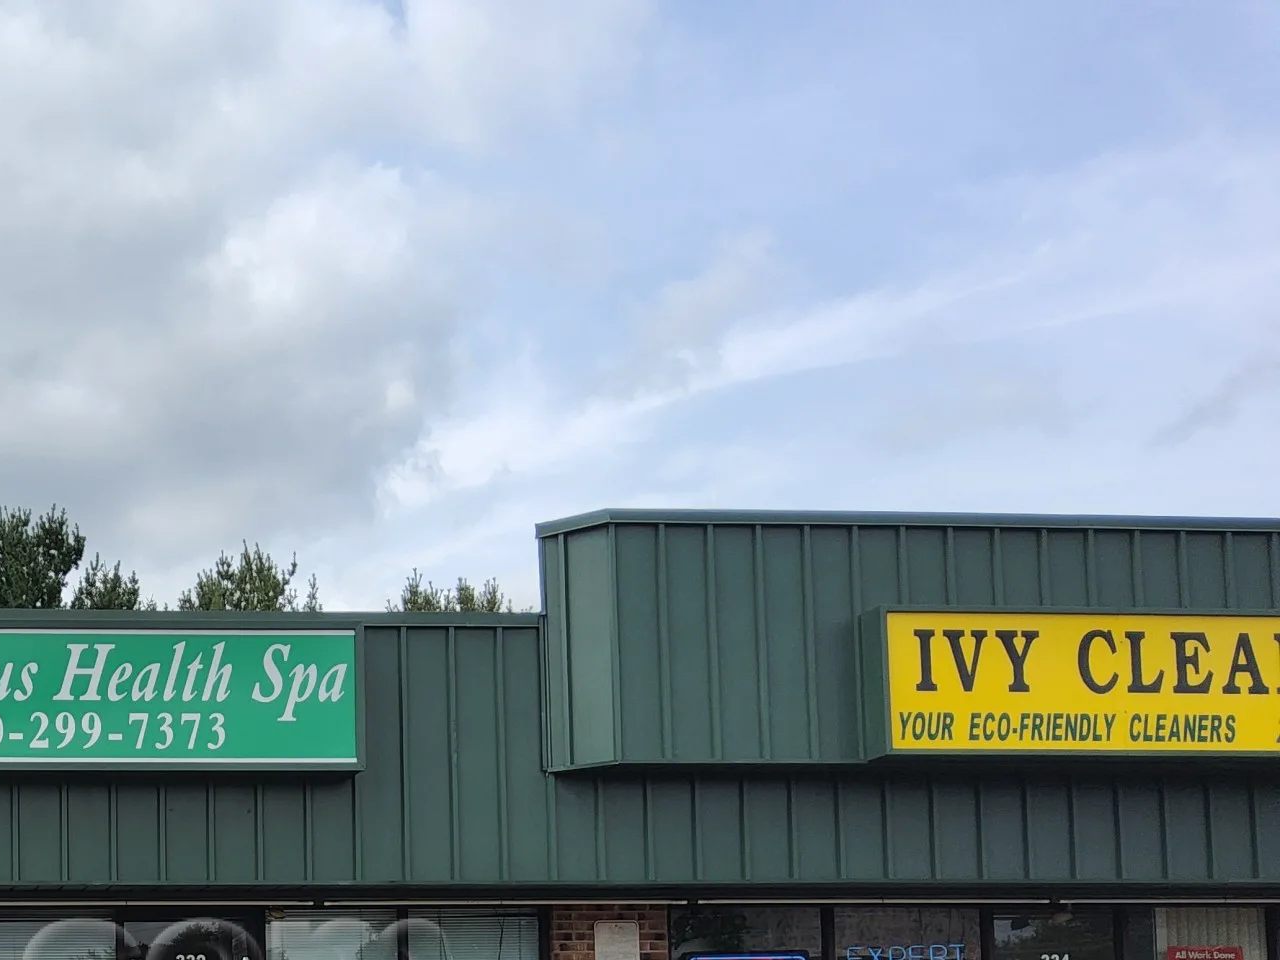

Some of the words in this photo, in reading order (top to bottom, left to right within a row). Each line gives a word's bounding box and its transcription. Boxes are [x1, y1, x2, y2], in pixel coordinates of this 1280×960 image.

[52, 641, 232, 703] Health
[251, 643, 348, 722] Spa
[914, 629, 1040, 693] IVY
[899, 711, 955, 741] YOUR
[969, 713, 1117, 742] ECO-FRIENDLY
[1129, 714, 1237, 743] CLEANERS
[1175, 951, 1187, 959] All
[1188, 951, 1212, 959] Work
[1213, 951, 1236, 959] Done
